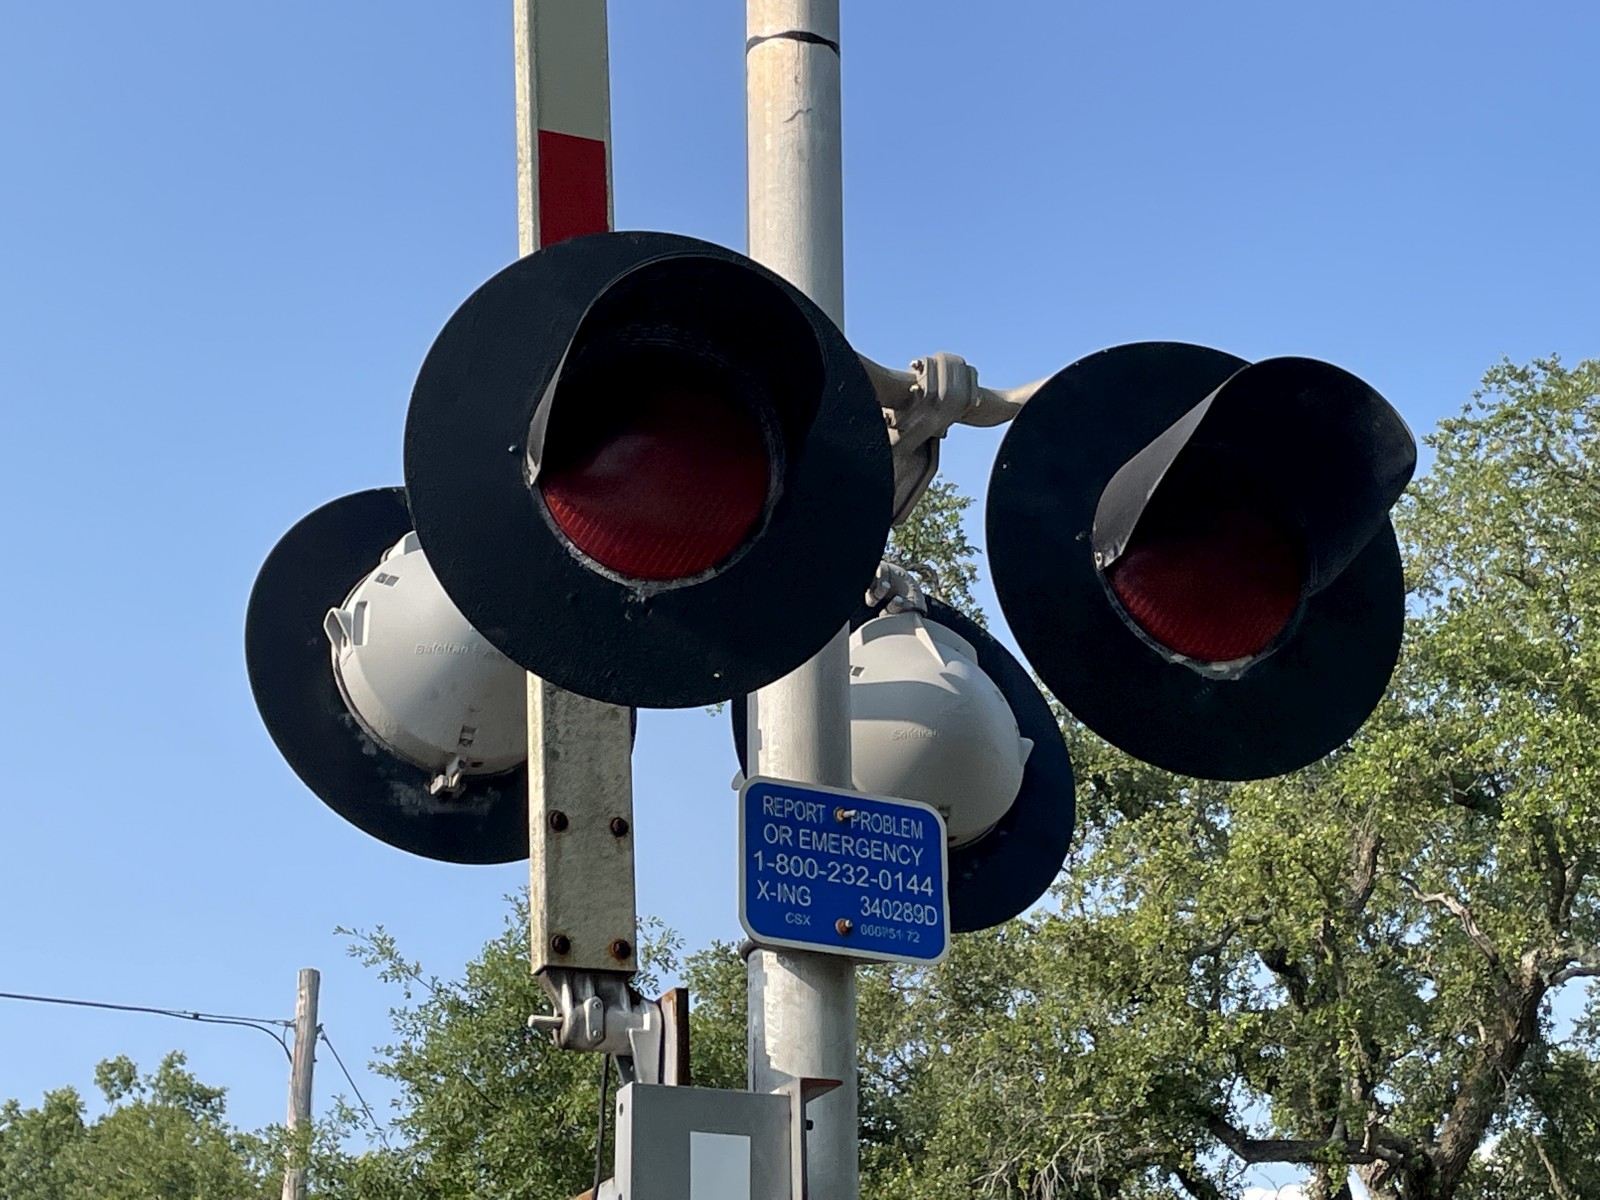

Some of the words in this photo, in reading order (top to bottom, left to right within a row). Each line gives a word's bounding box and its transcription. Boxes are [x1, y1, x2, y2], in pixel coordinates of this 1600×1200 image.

[762, 795, 826, 824] REPORT
[850, 809, 924, 840] PROBLEM
[763, 823, 793, 848] OR
[799, 828, 924, 867] EMERGENCY
[753, 850, 934, 897] 1-800-232-0144
[756, 879, 812, 907] X-ING
[859, 895, 938, 926] 340289D
[785, 911, 812, 926] CSX
